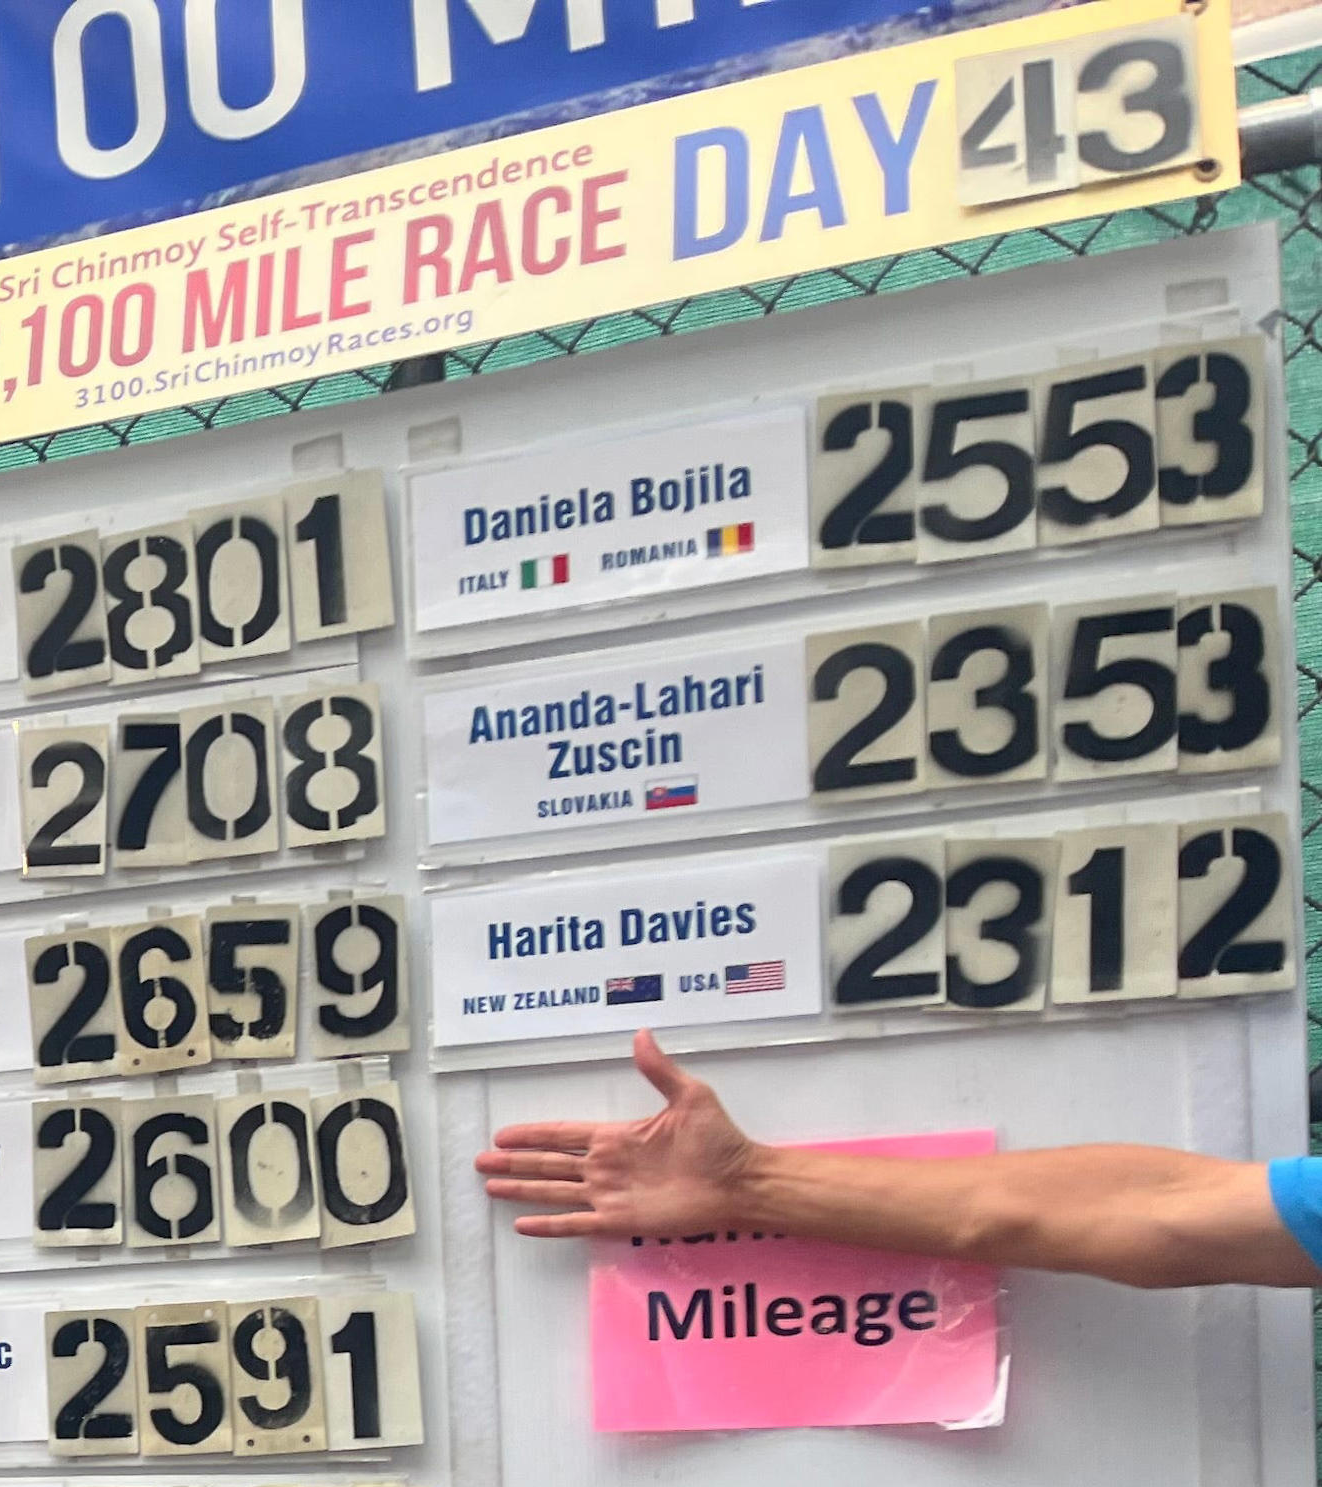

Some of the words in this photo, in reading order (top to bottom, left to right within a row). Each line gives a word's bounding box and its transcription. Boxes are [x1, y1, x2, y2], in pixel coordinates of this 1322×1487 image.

[961, 39, 1194, 184] 43
[52, 236, 207, 290] Chinmoy
[218, 143, 595, 253] Self-Transcendence
[181, 229, 376, 354] MILE
[403, 168, 629, 305] RACE
[672, 79, 938, 262] DAY
[463, 490, 615, 548] Daniela
[630, 462, 753, 519] Bojila
[820, 351, 1256, 551] 2553
[20, 493, 349, 678] 2801
[458, 568, 509, 596] ITALY
[600, 537, 698, 573] ROMANIA
[468, 665, 766, 745] Ananda-Lahari
[548, 729, 683, 781] Zuscin
[812, 602, 1273, 793] 2353
[26, 697, 379, 867] 2708
[537, 788, 634, 819] SLOVAKIA
[34, 904, 398, 1067] 2659
[488, 918, 605, 961] Harita
[619, 901, 757, 948] Davies
[679, 972, 720, 994] USA
[834, 827, 1287, 1008] 2312
[463, 995, 507, 1017] NEW
[512, 984, 600, 1012] ZEALAND
[38, 1098, 408, 1240] 2600
[52, 1307, 382, 1446] 2591
[647, 1282, 938, 1347] Mileage
